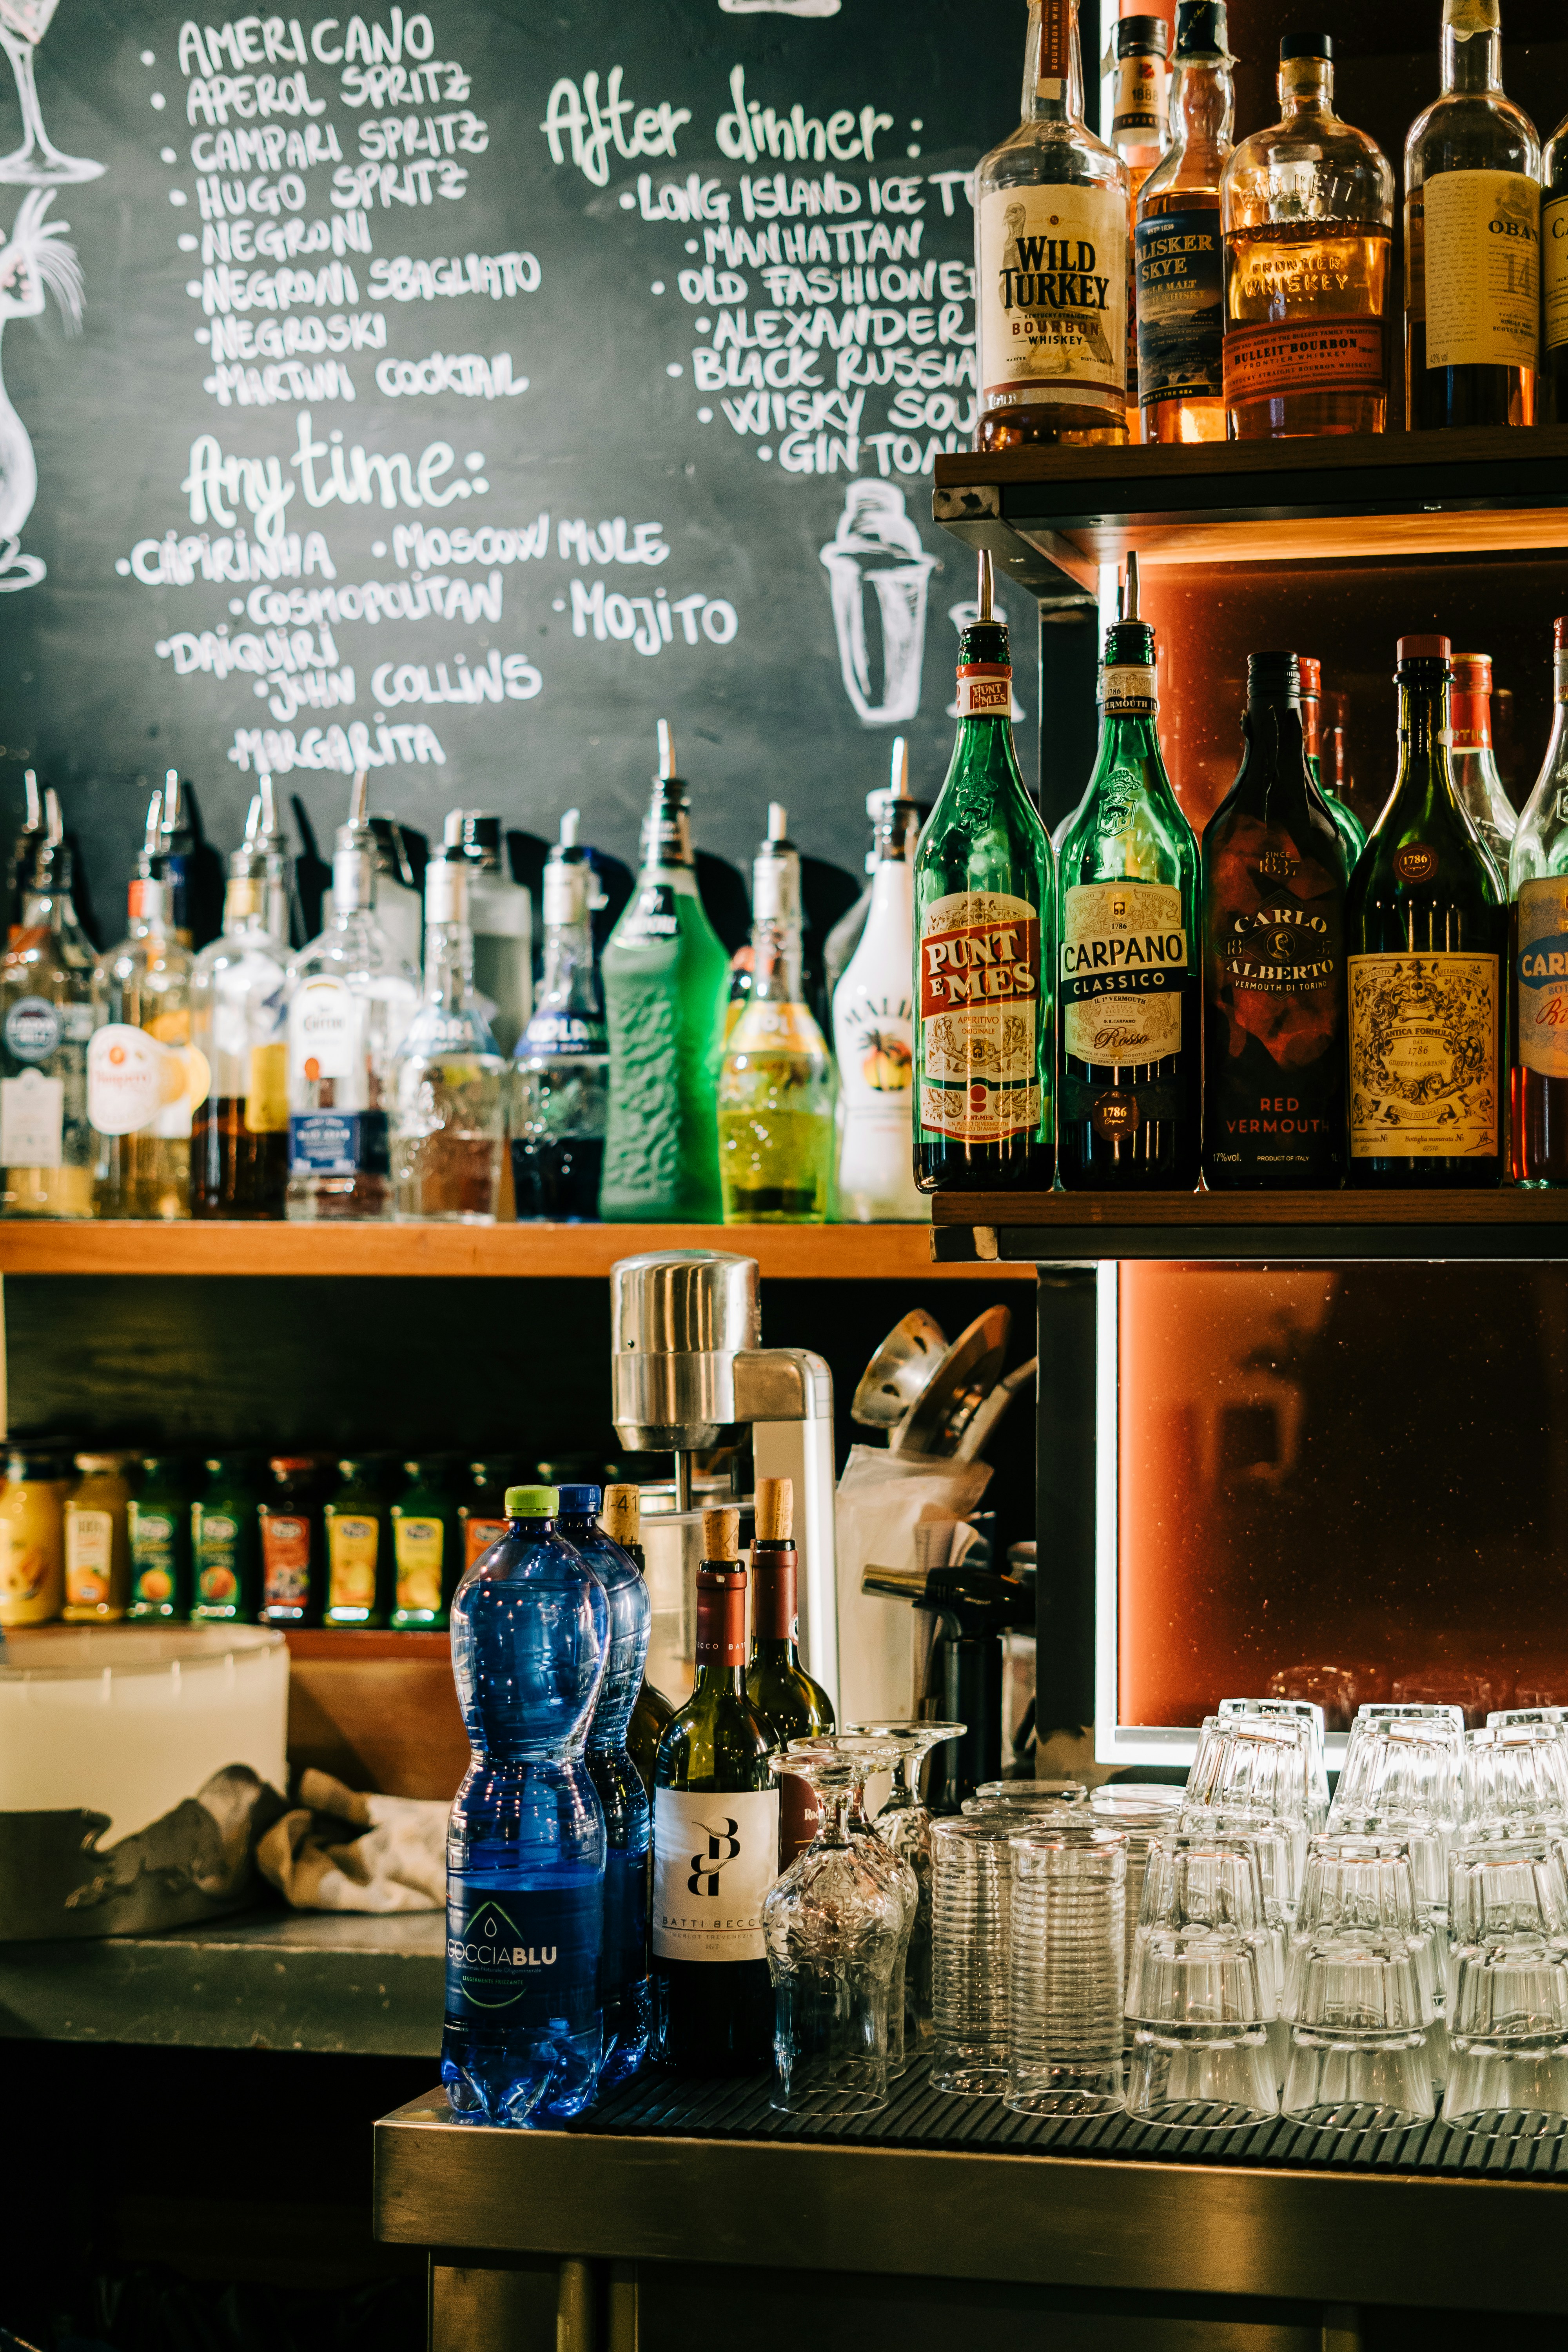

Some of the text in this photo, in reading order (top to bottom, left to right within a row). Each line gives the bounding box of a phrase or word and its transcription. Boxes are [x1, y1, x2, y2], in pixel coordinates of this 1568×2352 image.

[178, 6, 434, 77] AMERICANO
[187, 62, 471, 126] APEROL SPRITZ
[539, 65, 691, 186] After
[191, 110, 489, 172] CAMPARI SPRITZ
[196, 159, 468, 220] HUGO SPRITZ
[637, 172, 730, 223] LONG
[740, 171, 862, 222] ISLAND
[868, 176, 926, 215] ICE
[201, 209, 372, 265] NEGRONI
[1488, 220, 1538, 242] OBAN
[704, 219, 924, 268] MANHATTAN
[1016, 236, 1096, 272] WILD
[1135, 235, 1214, 261] ALISKER
[1142, 257, 1187, 282] SKYE
[1252, 257, 1341, 275] FRONTIER
[202, 252, 541, 315] NEGRONI SBAGLIATO
[678, 265, 748, 305] OLD
[999, 267, 1110, 310] TURKEY
[1166, 279, 1197, 290] MALT
[1245, 274, 1348, 297] WHISKEY
[211, 312, 387, 362] NEGROSKI
[713, 303, 976, 350] ALEXANDER
[1012, 321, 1099, 336] BOURBON
[1028, 335, 1083, 345] WHISKEY
[1235, 345, 1283, 365] BULLEIT
[1290, 338, 1357, 353] BOURBON
[692, 345, 976, 392] BLACK RUSSIA
[1243, 351, 1347, 370] FRONTIER WHISKEY
[215, 352, 529, 406] MARTINI COCKTAIL
[1258, 368, 1294, 378] STRAIGHT
[720, 388, 978, 436] WISKY SOU
[778, 432, 859, 475] GIN
[393, 513, 671, 571] MOSCOW MULE
[267, 666, 356, 722] JOHN
[974, 684, 1002, 696] PUNT
[981, 693, 1007, 705] MES
[1403, 855, 1428, 866] 1786
[1141, 893, 1175, 908] ORIGINALE
[1234, 909, 1327, 933] CARLO
[925, 929, 1019, 975] PUNT
[1064, 934, 1183, 973] CARPANO
[1226, 959, 1333, 980] ALBERTO
[944, 961, 1035, 1004] MES
[1073, 973, 1164, 995] CLASSICO
[1235, 980, 1281, 991] VERMOUTH
[1299, 980, 1327, 991] TORINO
[1109, 996, 1146, 1005] VERMOUTH
[1093, 1026, 1150, 1049] Rosso
[1385, 1027, 1455, 1038] ANTICA FORMULA
[1408, 1045, 1429, 1056] 1786
[1102, 1107, 1127, 1118] 1786
[1260, 1098, 1299, 1112] RED
[1226, 1119, 1330, 1133] VERMOUTH
[1405, 1136, 1427, 1144] Bottiglia
[662, 1916, 755, 1928] BATTI BECC
[463, 1975, 494, 1984] LEGGERMENTE
